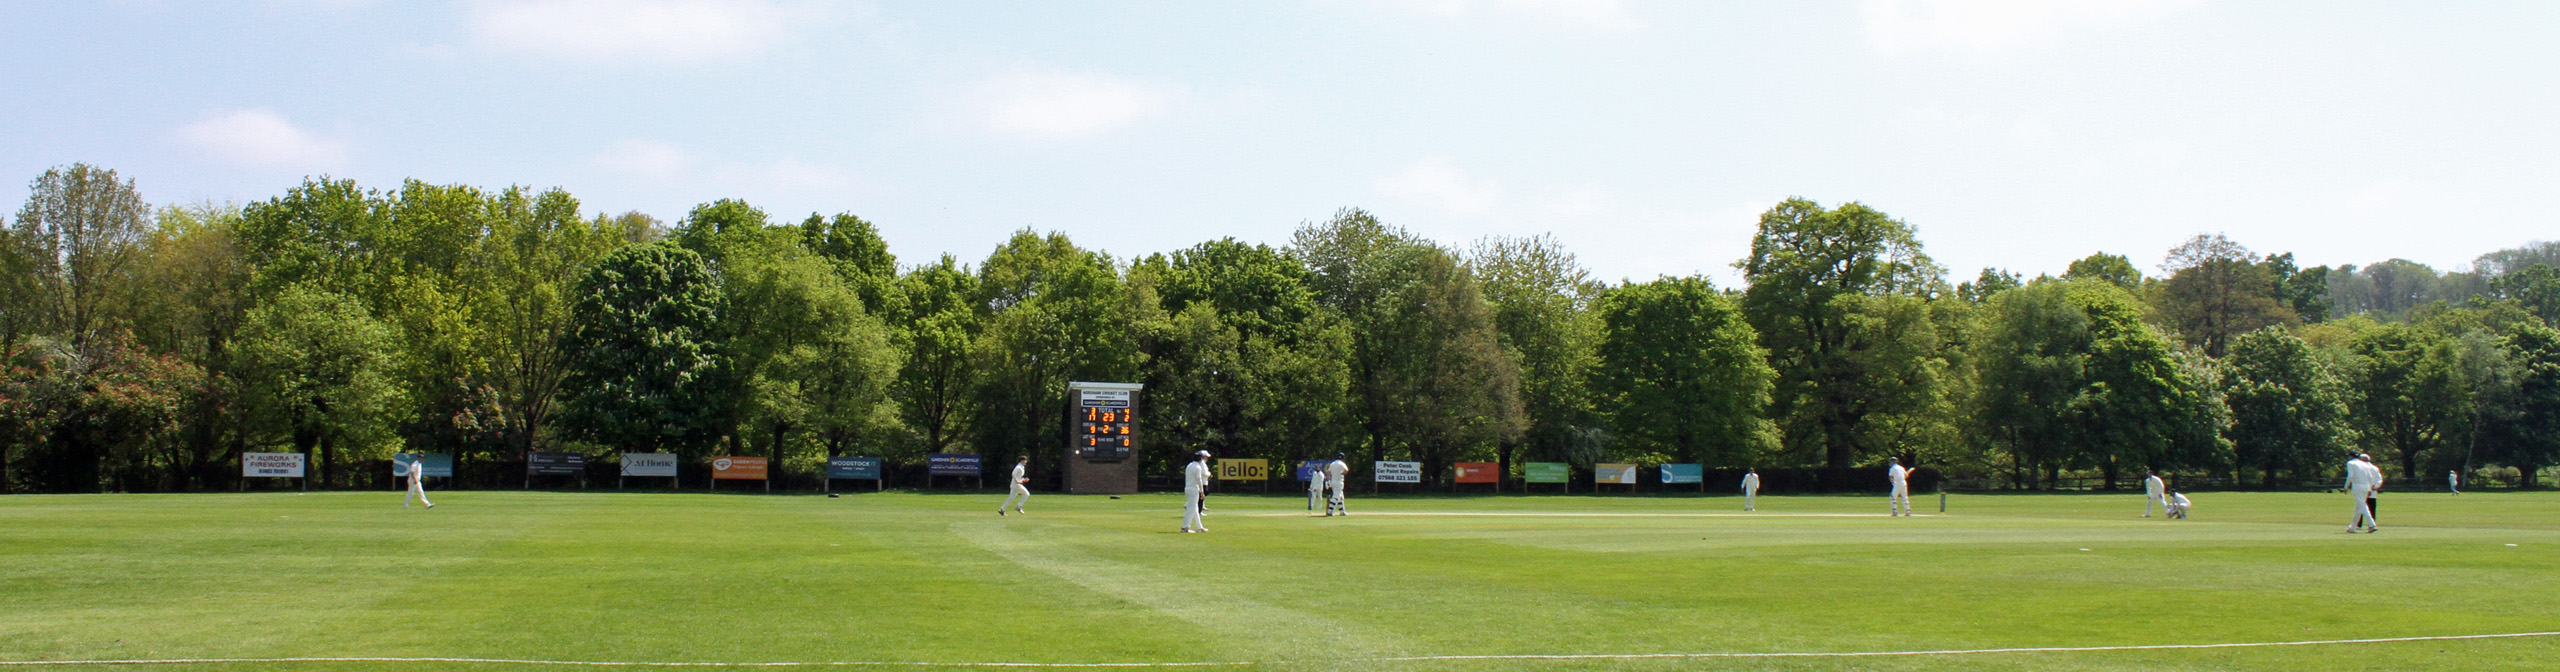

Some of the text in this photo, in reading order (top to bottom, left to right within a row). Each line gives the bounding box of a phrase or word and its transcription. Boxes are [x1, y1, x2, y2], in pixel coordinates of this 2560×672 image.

[1102, 412, 1114, 422] 23
[1090, 425, 1096, 434] 9
[1102, 424, 1109, 434] 2
[1120, 426, 1130, 434] 36
[1090, 438, 1096, 446] 3
[1124, 438, 1130, 447] 0
[646, 460, 673, 468] Home
[1222, 462, 1263, 477] lello:
